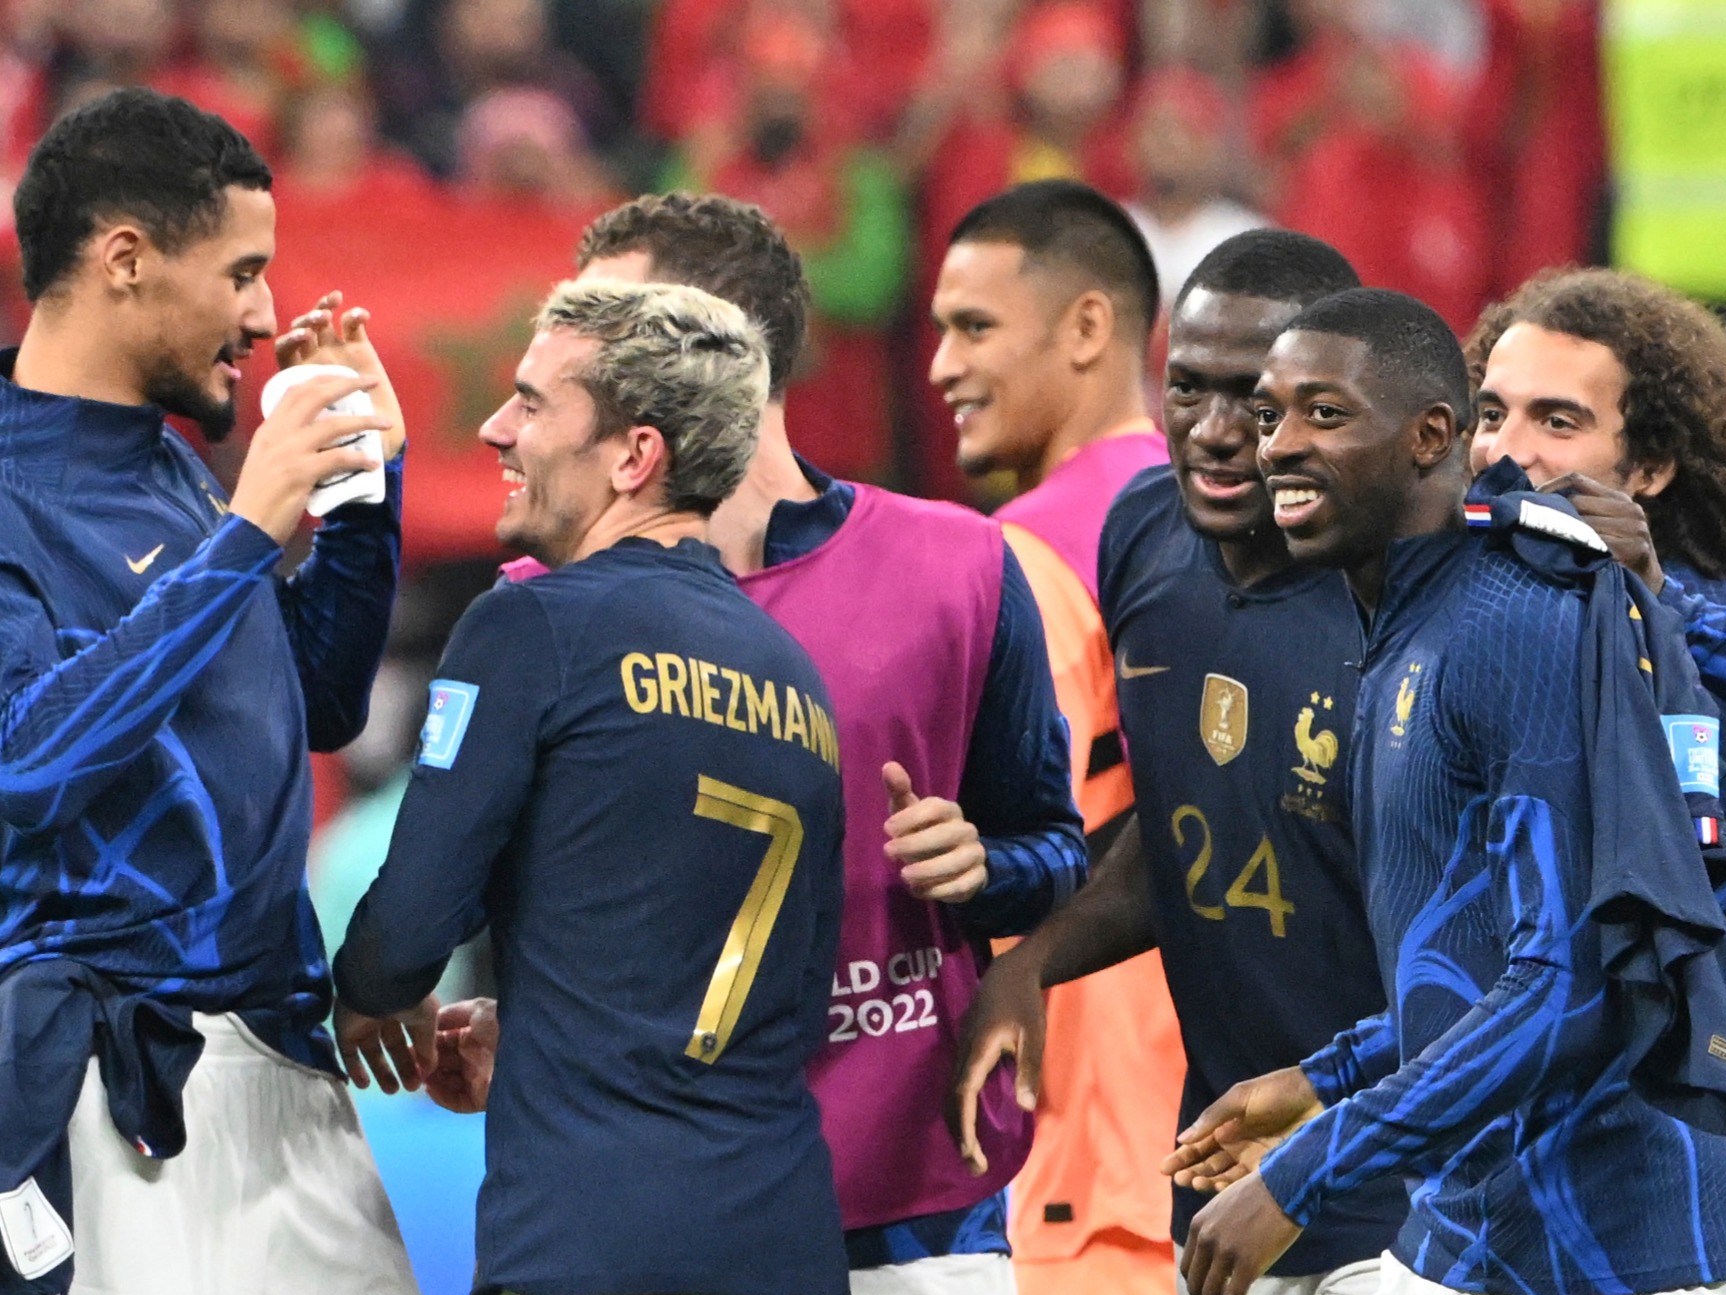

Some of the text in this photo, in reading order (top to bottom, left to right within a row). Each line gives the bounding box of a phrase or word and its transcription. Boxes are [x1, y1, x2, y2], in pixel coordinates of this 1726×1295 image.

[684, 773, 805, 1065] 7
[1171, 804, 1296, 938] 24
[827, 989, 938, 1043] 2022
